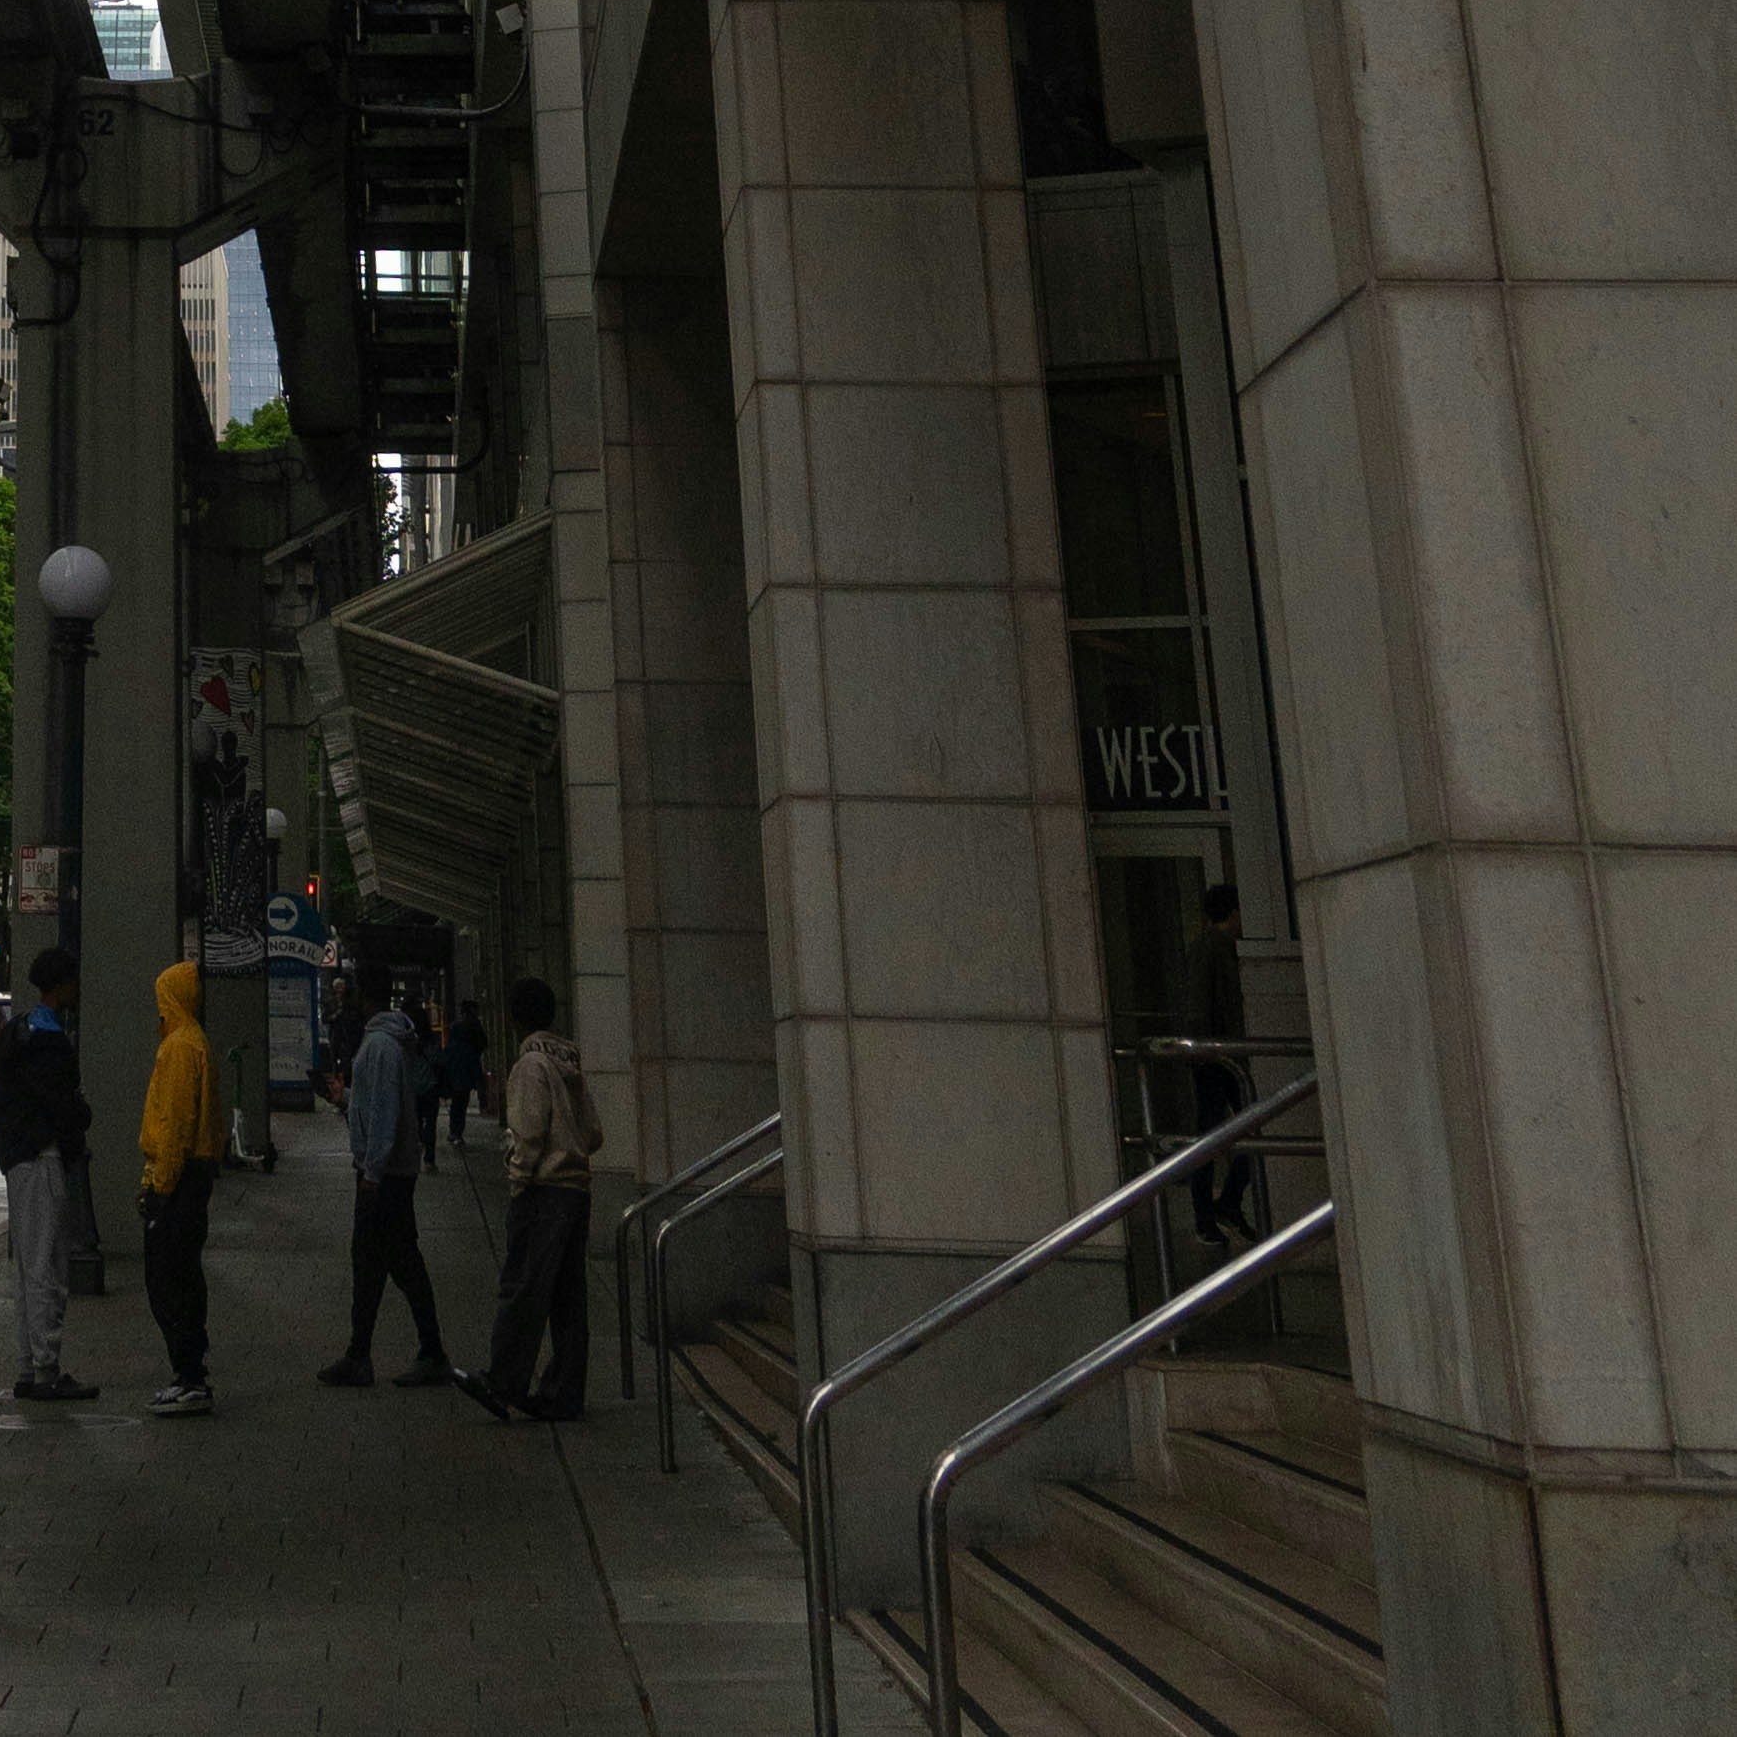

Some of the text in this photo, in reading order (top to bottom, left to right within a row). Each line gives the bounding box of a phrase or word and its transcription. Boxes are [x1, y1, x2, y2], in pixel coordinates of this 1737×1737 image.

[80, 109, 114, 135] 62
[1096, 723, 1228, 798] WESTL
[269, 940, 316, 960] NORAIL
